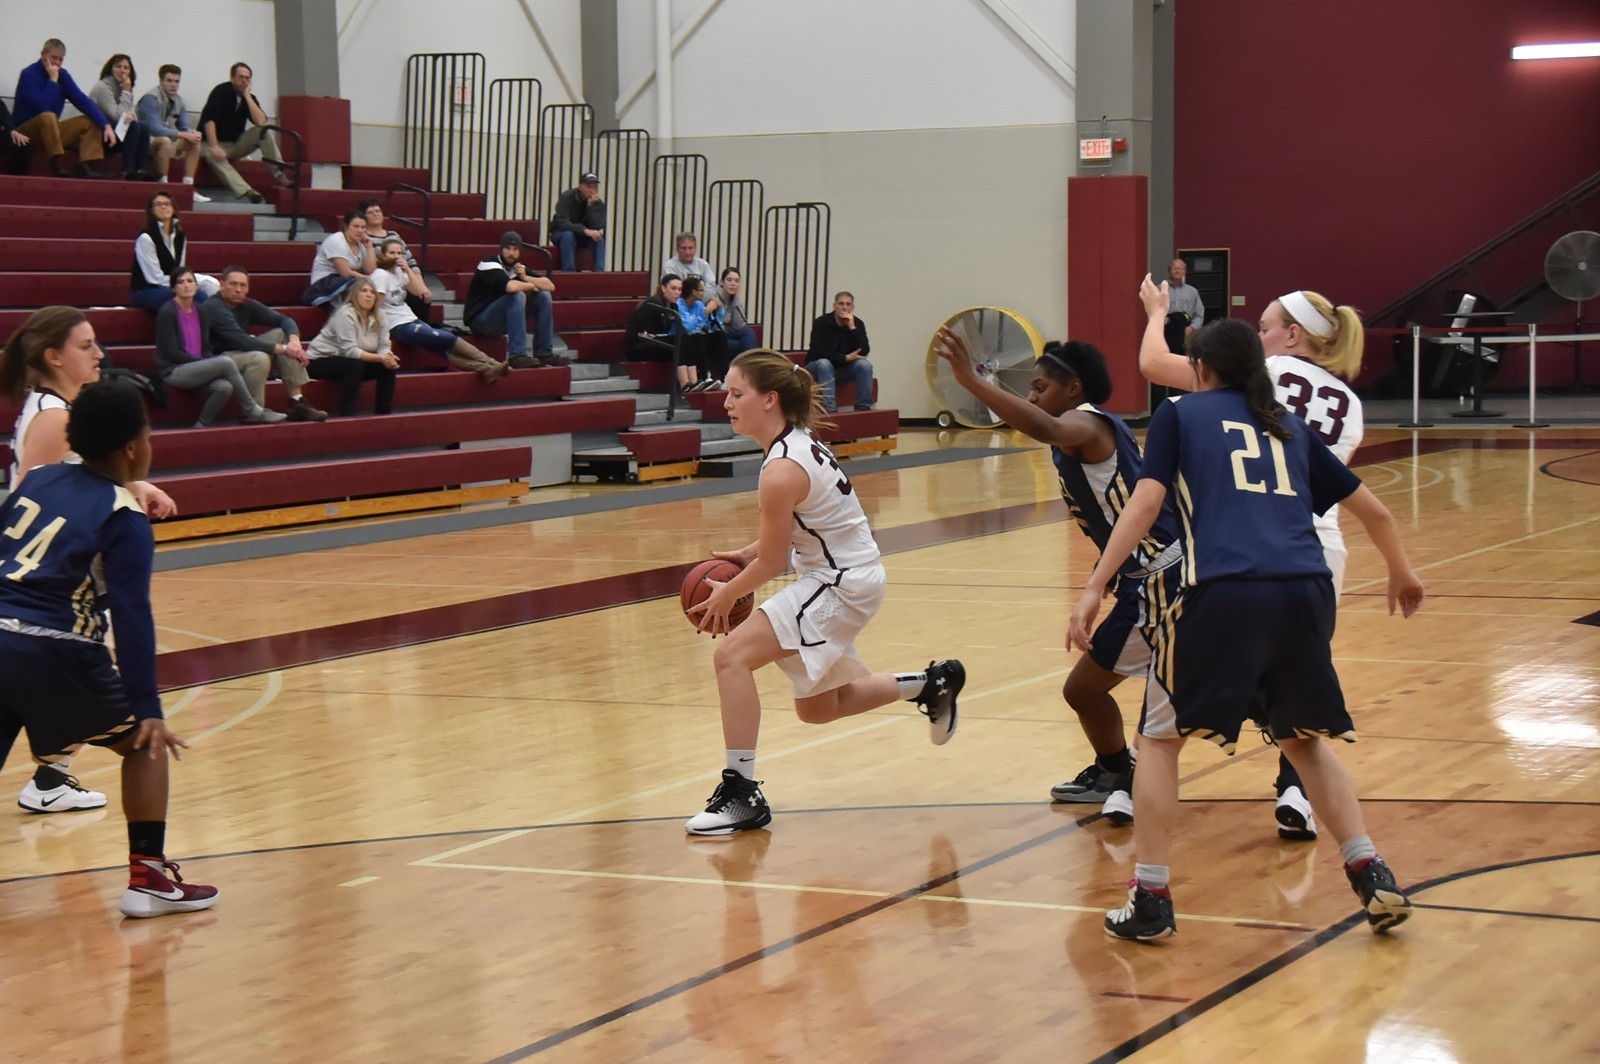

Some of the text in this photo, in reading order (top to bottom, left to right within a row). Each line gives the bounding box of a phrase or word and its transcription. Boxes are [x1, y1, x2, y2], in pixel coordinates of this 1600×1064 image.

[1086, 140, 1107, 157] EXIT
[1278, 372, 1350, 446] 33
[1222, 420, 1298, 496] 21
